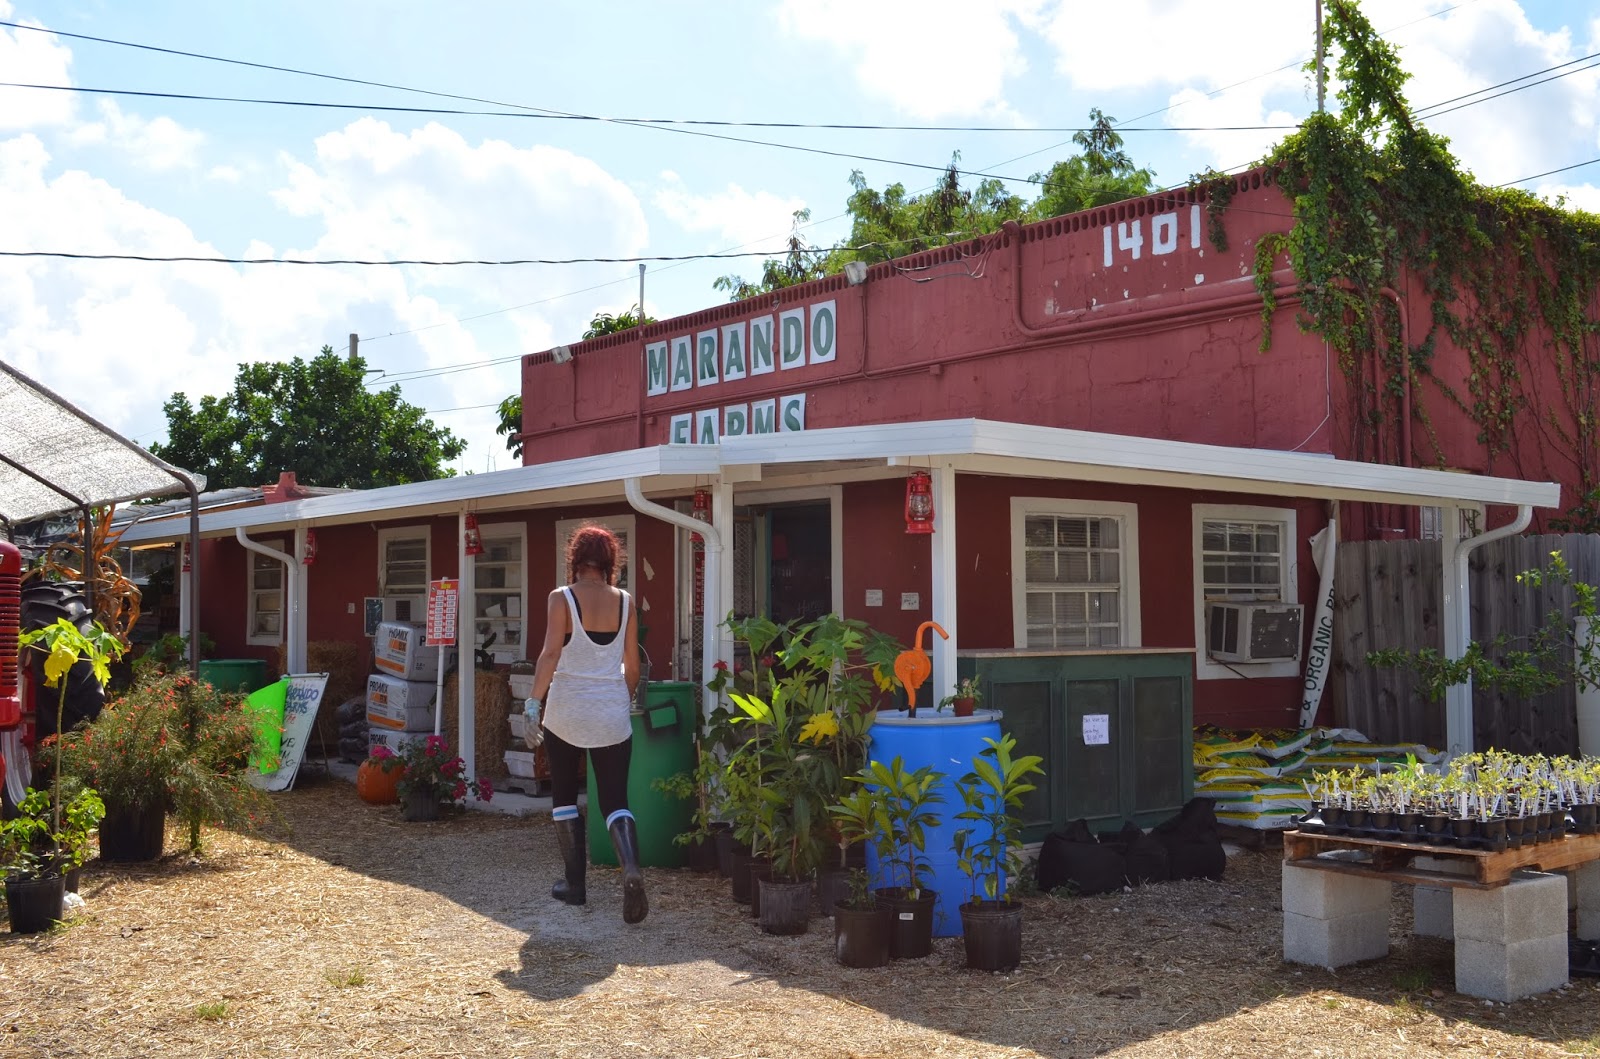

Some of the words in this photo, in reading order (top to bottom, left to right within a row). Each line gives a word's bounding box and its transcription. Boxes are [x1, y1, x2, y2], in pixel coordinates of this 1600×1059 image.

[1103, 204, 1200, 267] 1401
[648, 307, 834, 391] MARANDO
[674, 399, 801, 444] FARMS
[1304, 616, 1333, 691] ORGANIC
